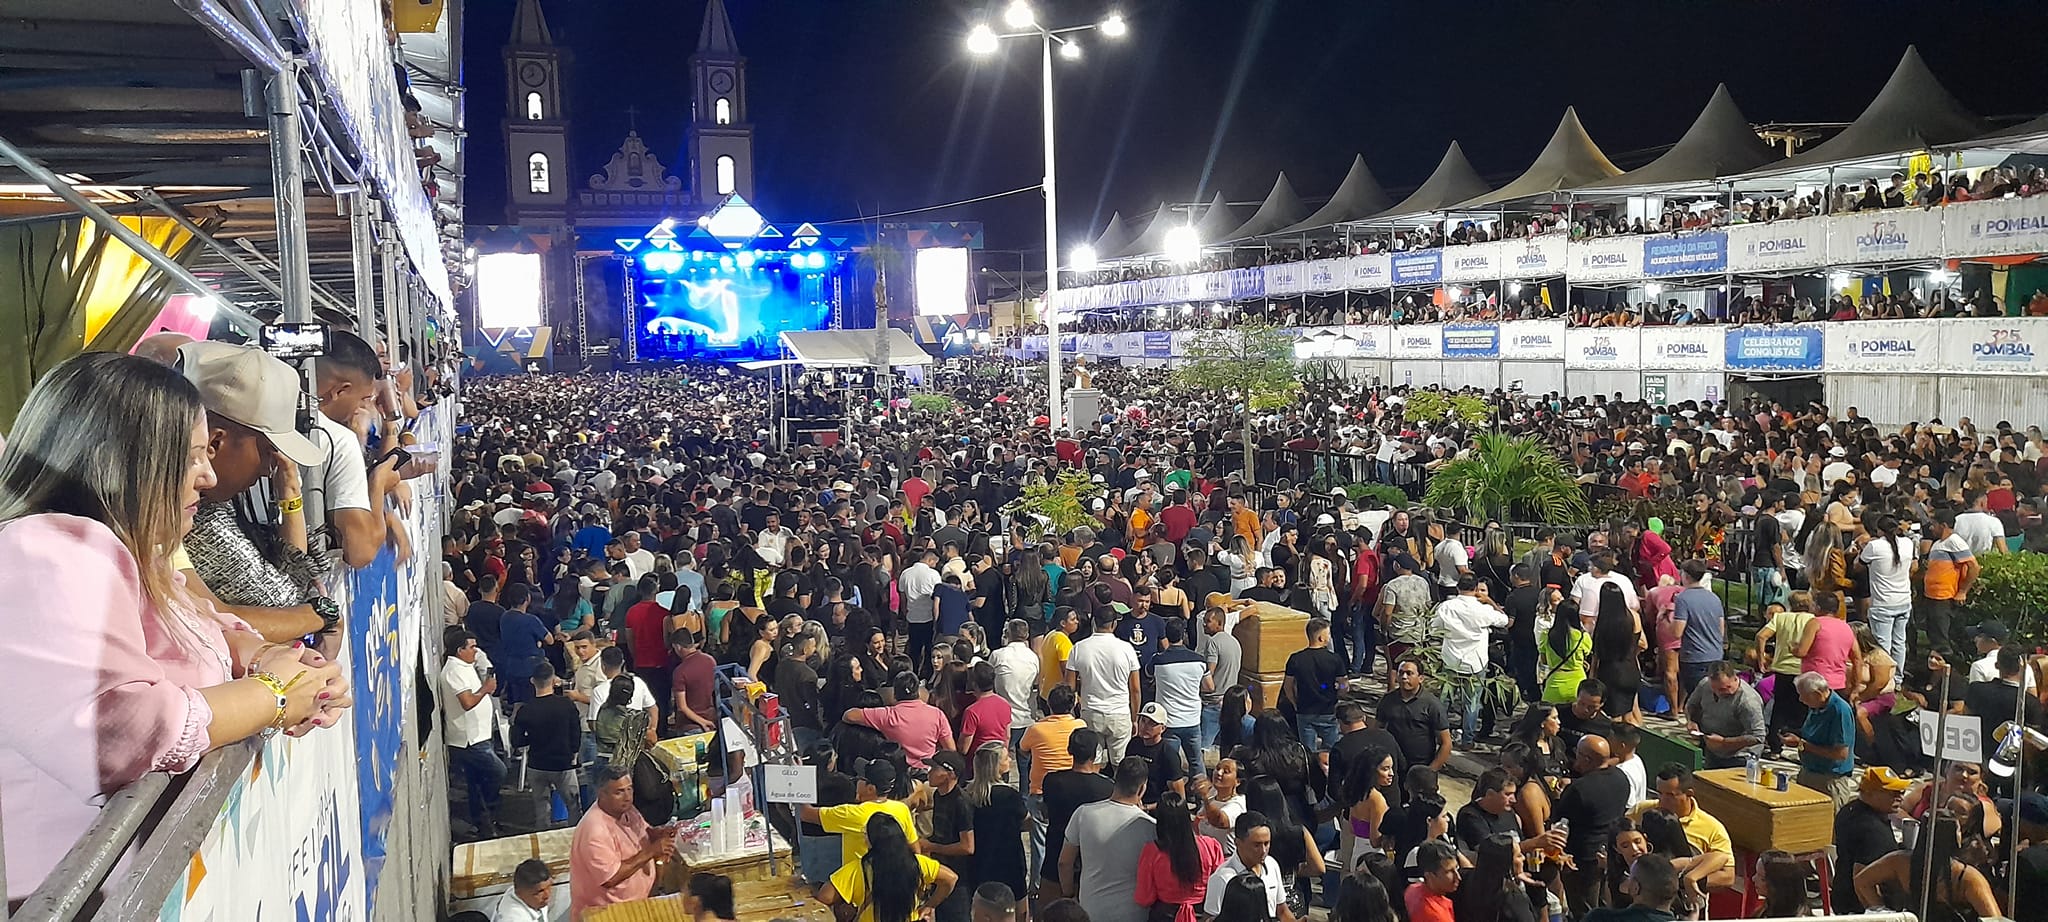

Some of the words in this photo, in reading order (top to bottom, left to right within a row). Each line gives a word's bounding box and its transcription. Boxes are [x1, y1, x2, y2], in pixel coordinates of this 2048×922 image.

[1759, 238, 1806, 252] POMBAL
[1461, 256, 1489, 267] POMBAL
[1517, 254, 1548, 265] POMBAL
[1592, 253, 1628, 265] POMBAL
[1407, 337, 1432, 346] POMBAL
[1520, 335, 1553, 345] POMBAL
[1743, 337, 1802, 347] CELEBRANDO
[1583, 346, 1618, 357] POMBAL
[1667, 343, 1709, 354] POMBAL
[1861, 340, 1916, 352] POMBAL
[1972, 342, 2035, 356] POMBAL
[1743, 347, 1801, 357] CONQUISTAS
